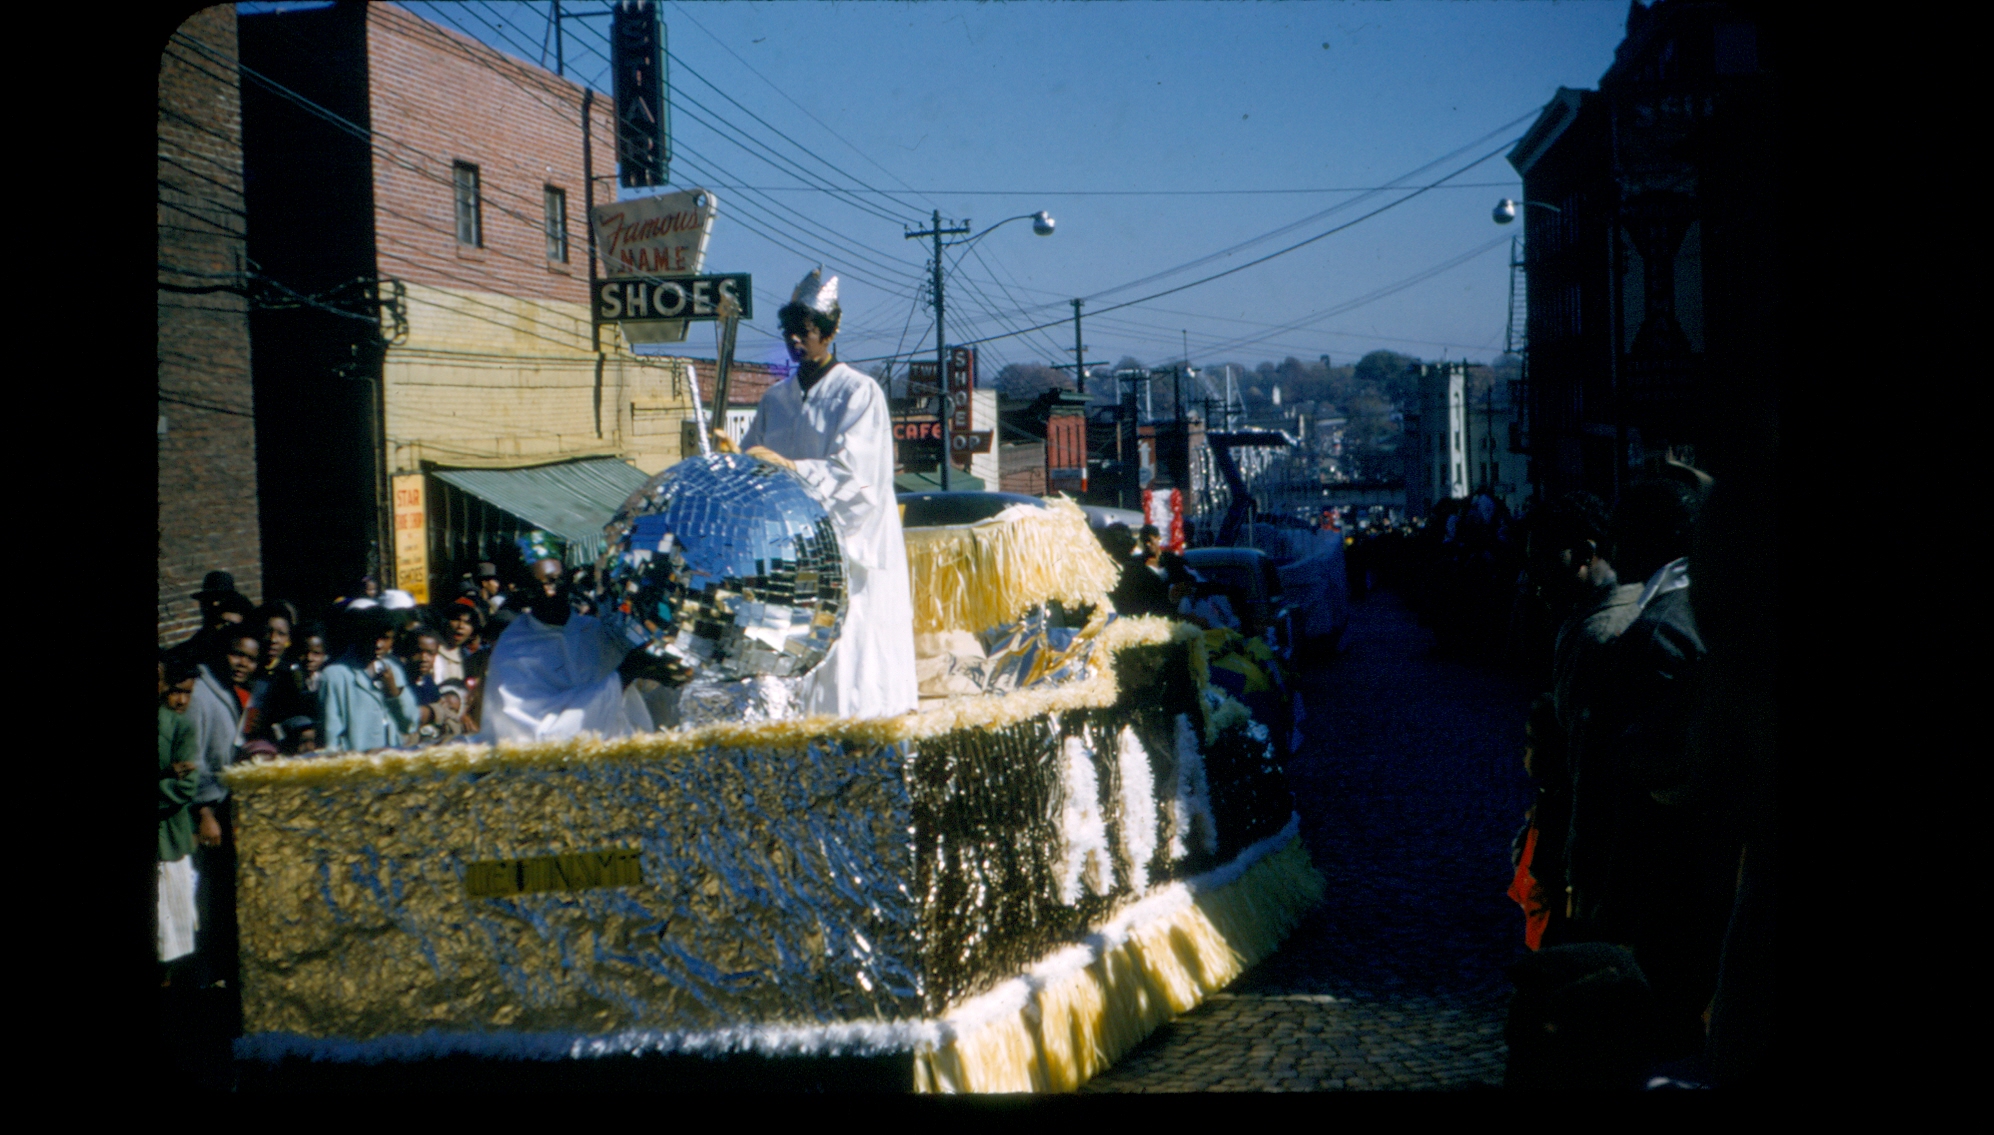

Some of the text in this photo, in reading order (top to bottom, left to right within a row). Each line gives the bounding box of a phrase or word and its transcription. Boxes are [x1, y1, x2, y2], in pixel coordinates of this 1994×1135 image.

[601, 208, 700, 254] Famous
[617, 246, 688, 273] NAME
[601, 278, 742, 319] SHOES
[954, 350, 968, 427] SHOE
[893, 423, 942, 440] CAFE
[396, 489, 420, 507] STAR
